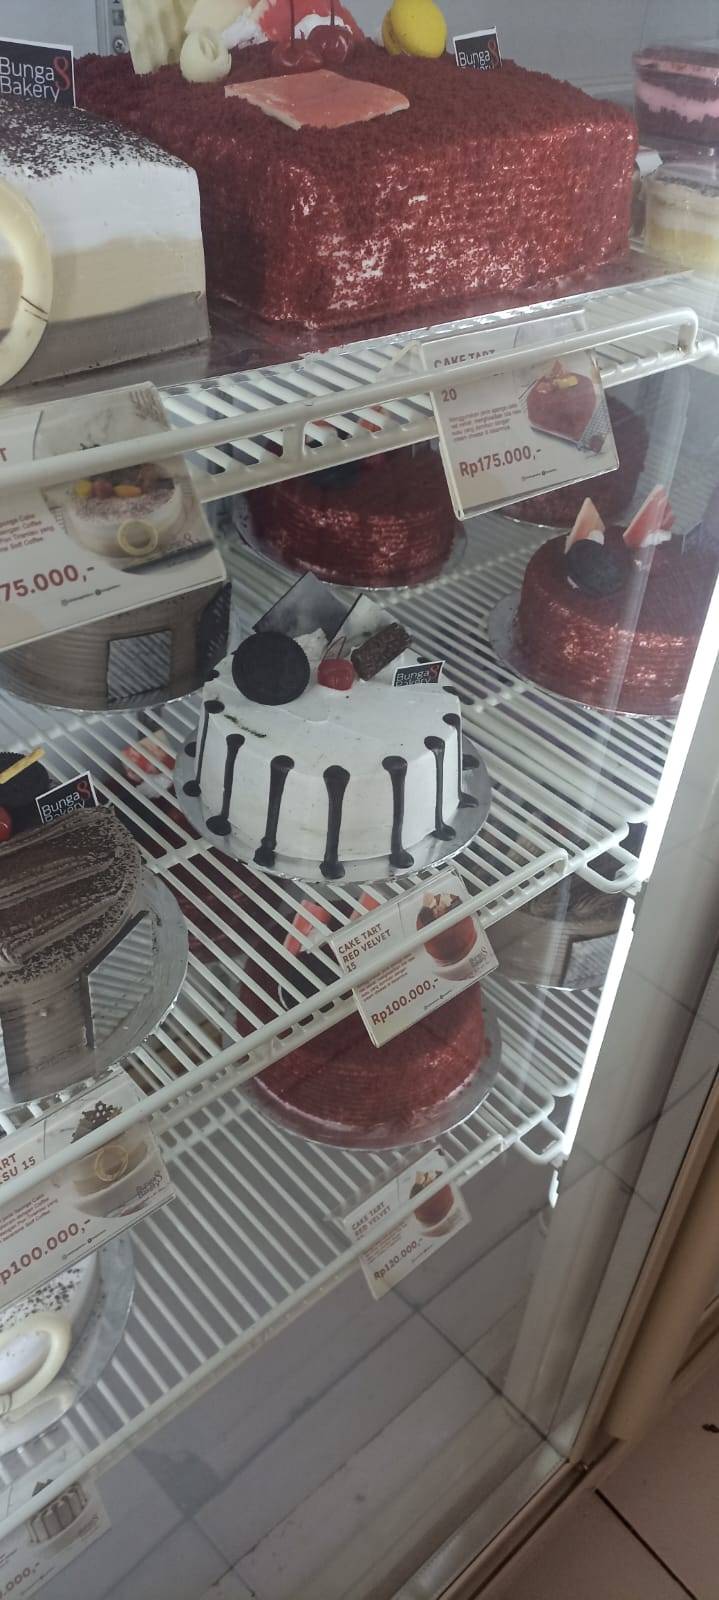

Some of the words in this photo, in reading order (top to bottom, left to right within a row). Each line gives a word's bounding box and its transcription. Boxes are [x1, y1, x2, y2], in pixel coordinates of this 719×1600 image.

[0, 56, 55, 84] Bunga
[458, 50, 491, 67] Bunga
[0, 75, 60, 103] Bakery
[441, 387, 457, 402] 20
[459, 445, 542, 478] Rp175.000,-
[41, 791, 81, 817] Bunga
[338, 936, 362, 954] CAKE
[361, 923, 383, 940] TART
[342, 949, 360, 963] RED
[361, 929, 392, 952] VELVET
[371, 977, 439, 1026] Rp100.000,-
[0, 1166, 19, 1184] SU
[22, 1155, 37, 1171] 15
[0, 1218, 91, 1286] p100.000,-
